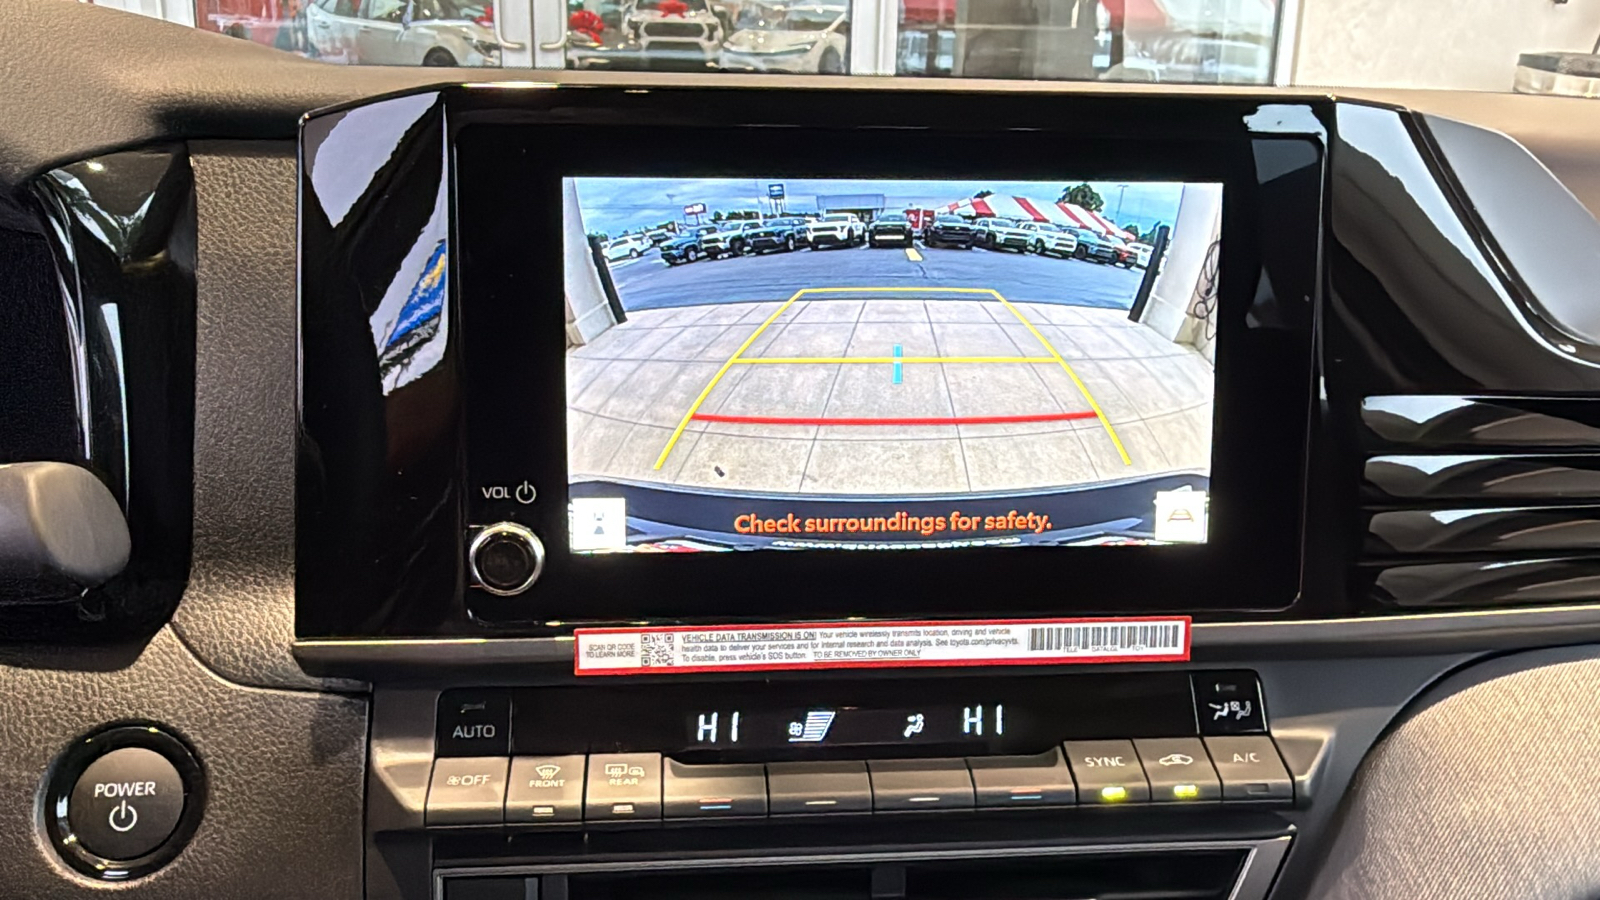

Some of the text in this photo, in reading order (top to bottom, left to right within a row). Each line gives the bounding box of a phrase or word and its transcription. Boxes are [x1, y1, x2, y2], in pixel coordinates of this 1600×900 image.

[482, 486, 511, 499] VOL
[733, 510, 1053, 535] Check surroundings for safety.
[681, 627, 1011, 643] VEHICLE DATA TRANSMISSION IS ON! Your vehicle wirelessly transmits location, driving and vehicle
[588, 642, 635, 652] SCAN QR CODE
[681, 644, 702, 653] health
[703, 644, 719, 652] data
[720, 643, 728, 652] to
[728, 642, 751, 651] deliver
[751, 642, 767, 652] your
[767, 640, 795, 650] services
[796, 640, 809, 650] and
[810, 640, 820, 649] for
[821, 639, 846, 649] internal
[846, 638, 875, 648] research
[876, 638, 889, 648] and
[889, 637, 905, 647] data
[905, 637, 933, 648] analysis.
[935, 638, 949, 647] See
[585, 649, 635, 659] TO LEARN MORE
[681, 653, 690, 662] To
[691, 653, 717, 662] disable,
[719, 652, 737, 662] press
[738, 651, 767, 661] vehicle's
[767, 650, 783, 660] SOS
[813, 651, 823, 659] TO
[823, 649, 833, 658] BE
[833, 648, 867, 658] REMOVED
[867, 648, 877, 658] BY
[879, 647, 903, 657] OWNER
[903, 647, 922, 657] ONLY
[452, 724, 496, 739] AUTO
[1083, 755, 1127, 769] SYNC
[1232, 751, 1261, 764] A/C
[461, 774, 492, 786] OFF
[528, 779, 566, 789] FRONT
[608, 777, 640, 786] REAR
[94, 781, 156, 798] POWER
